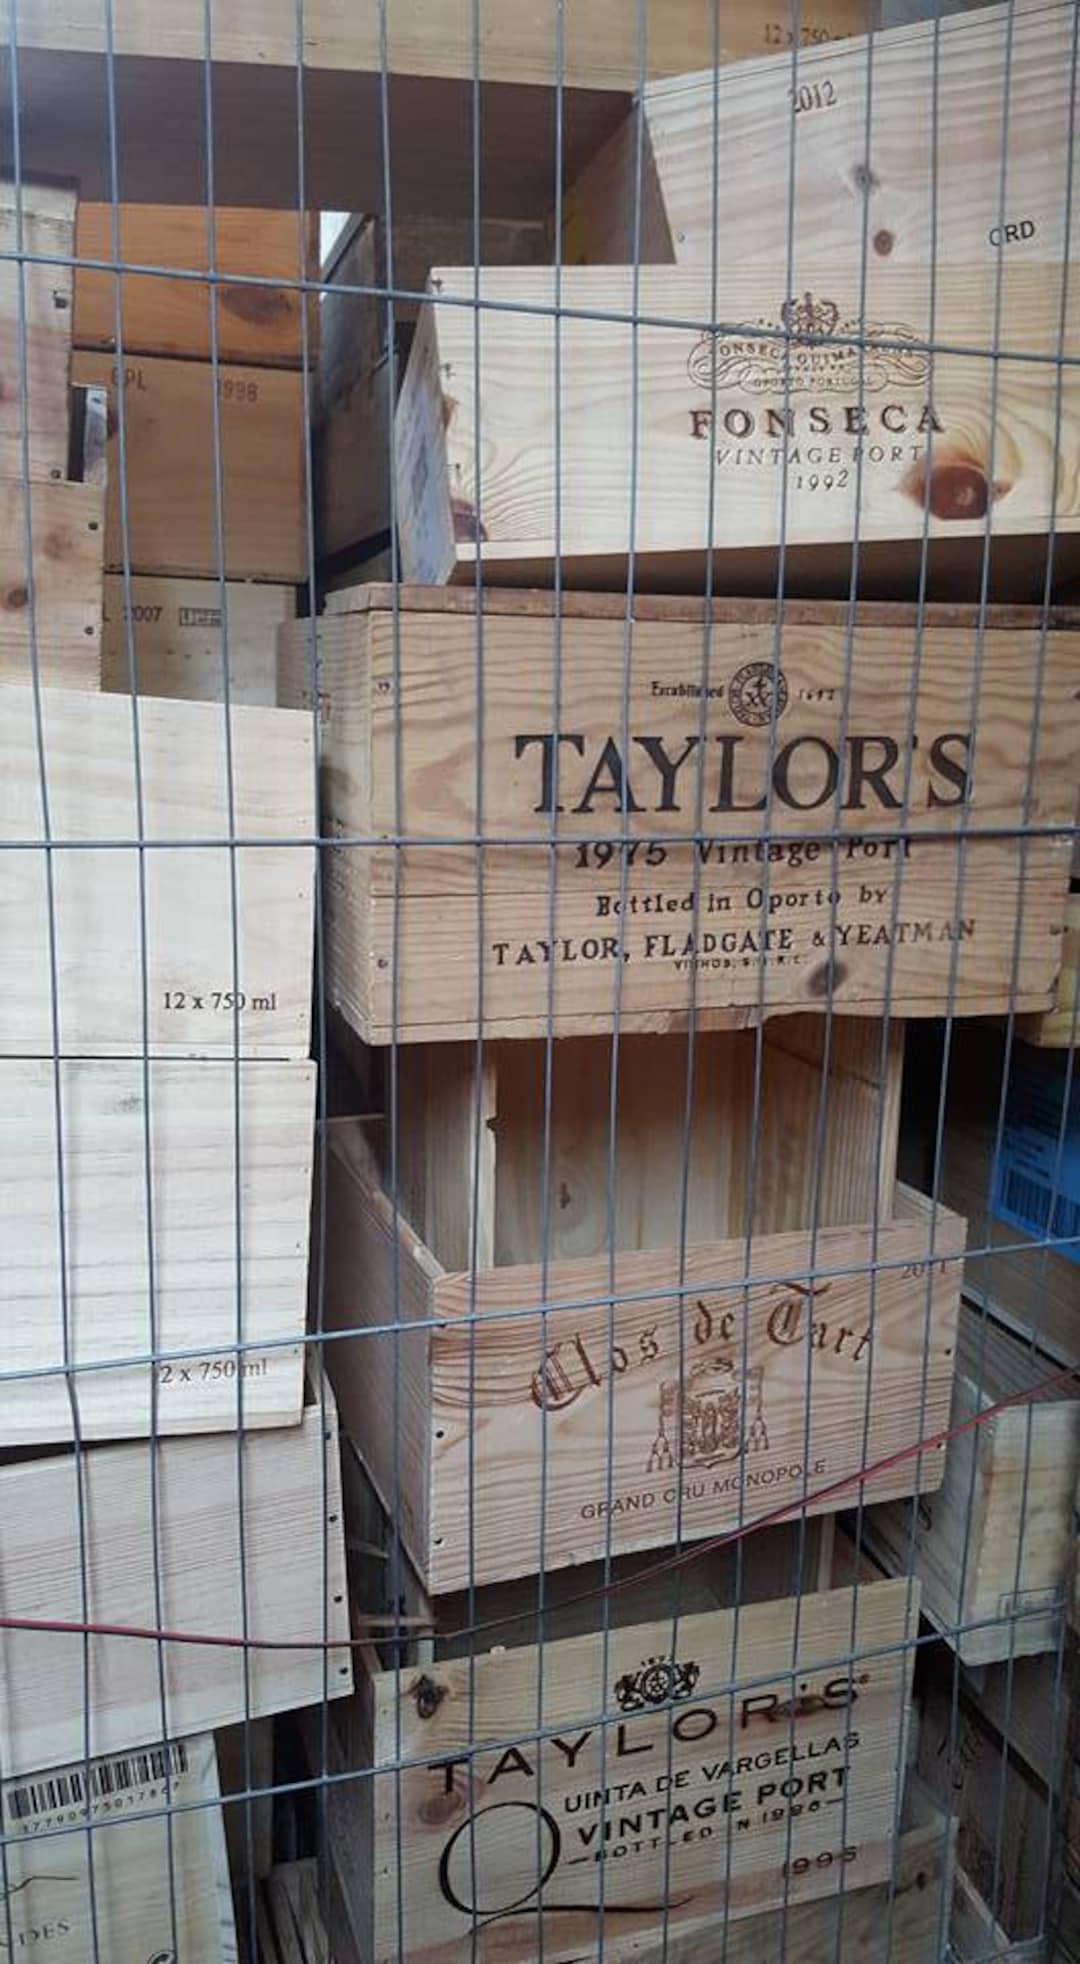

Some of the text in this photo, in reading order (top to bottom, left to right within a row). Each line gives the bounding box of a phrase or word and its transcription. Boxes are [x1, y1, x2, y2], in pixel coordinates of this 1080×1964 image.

[787, 80, 838, 113] 2012
[688, 405, 943, 440] FONSECA
[716, 446, 924, 465] VINTAGE PORT
[796, 470, 850, 491] 1992
[514, 733, 974, 813] TAYLOR'S
[574, 841, 667, 869] 1975
[699, 839, 820, 868] Vintage
[595, 886, 888, 916] Bottled in Oporto by
[492, 919, 976, 966] TAYLOR, FLADGATE & YEATMAN
[163, 989, 277, 1010] 12 x 750 ml
[693, 1300, 735, 1345] de
[179, 1366, 190, 1382] x
[199, 1360, 235, 1381] 750
[580, 1493, 655, 1519] GRAND
[662, 1486, 705, 1505] CRU
[655, 1770, 691, 1793] DE
[701, 1732, 861, 1781] VARGELLAS
[578, 1766, 852, 1846] VINTAGE PORT
